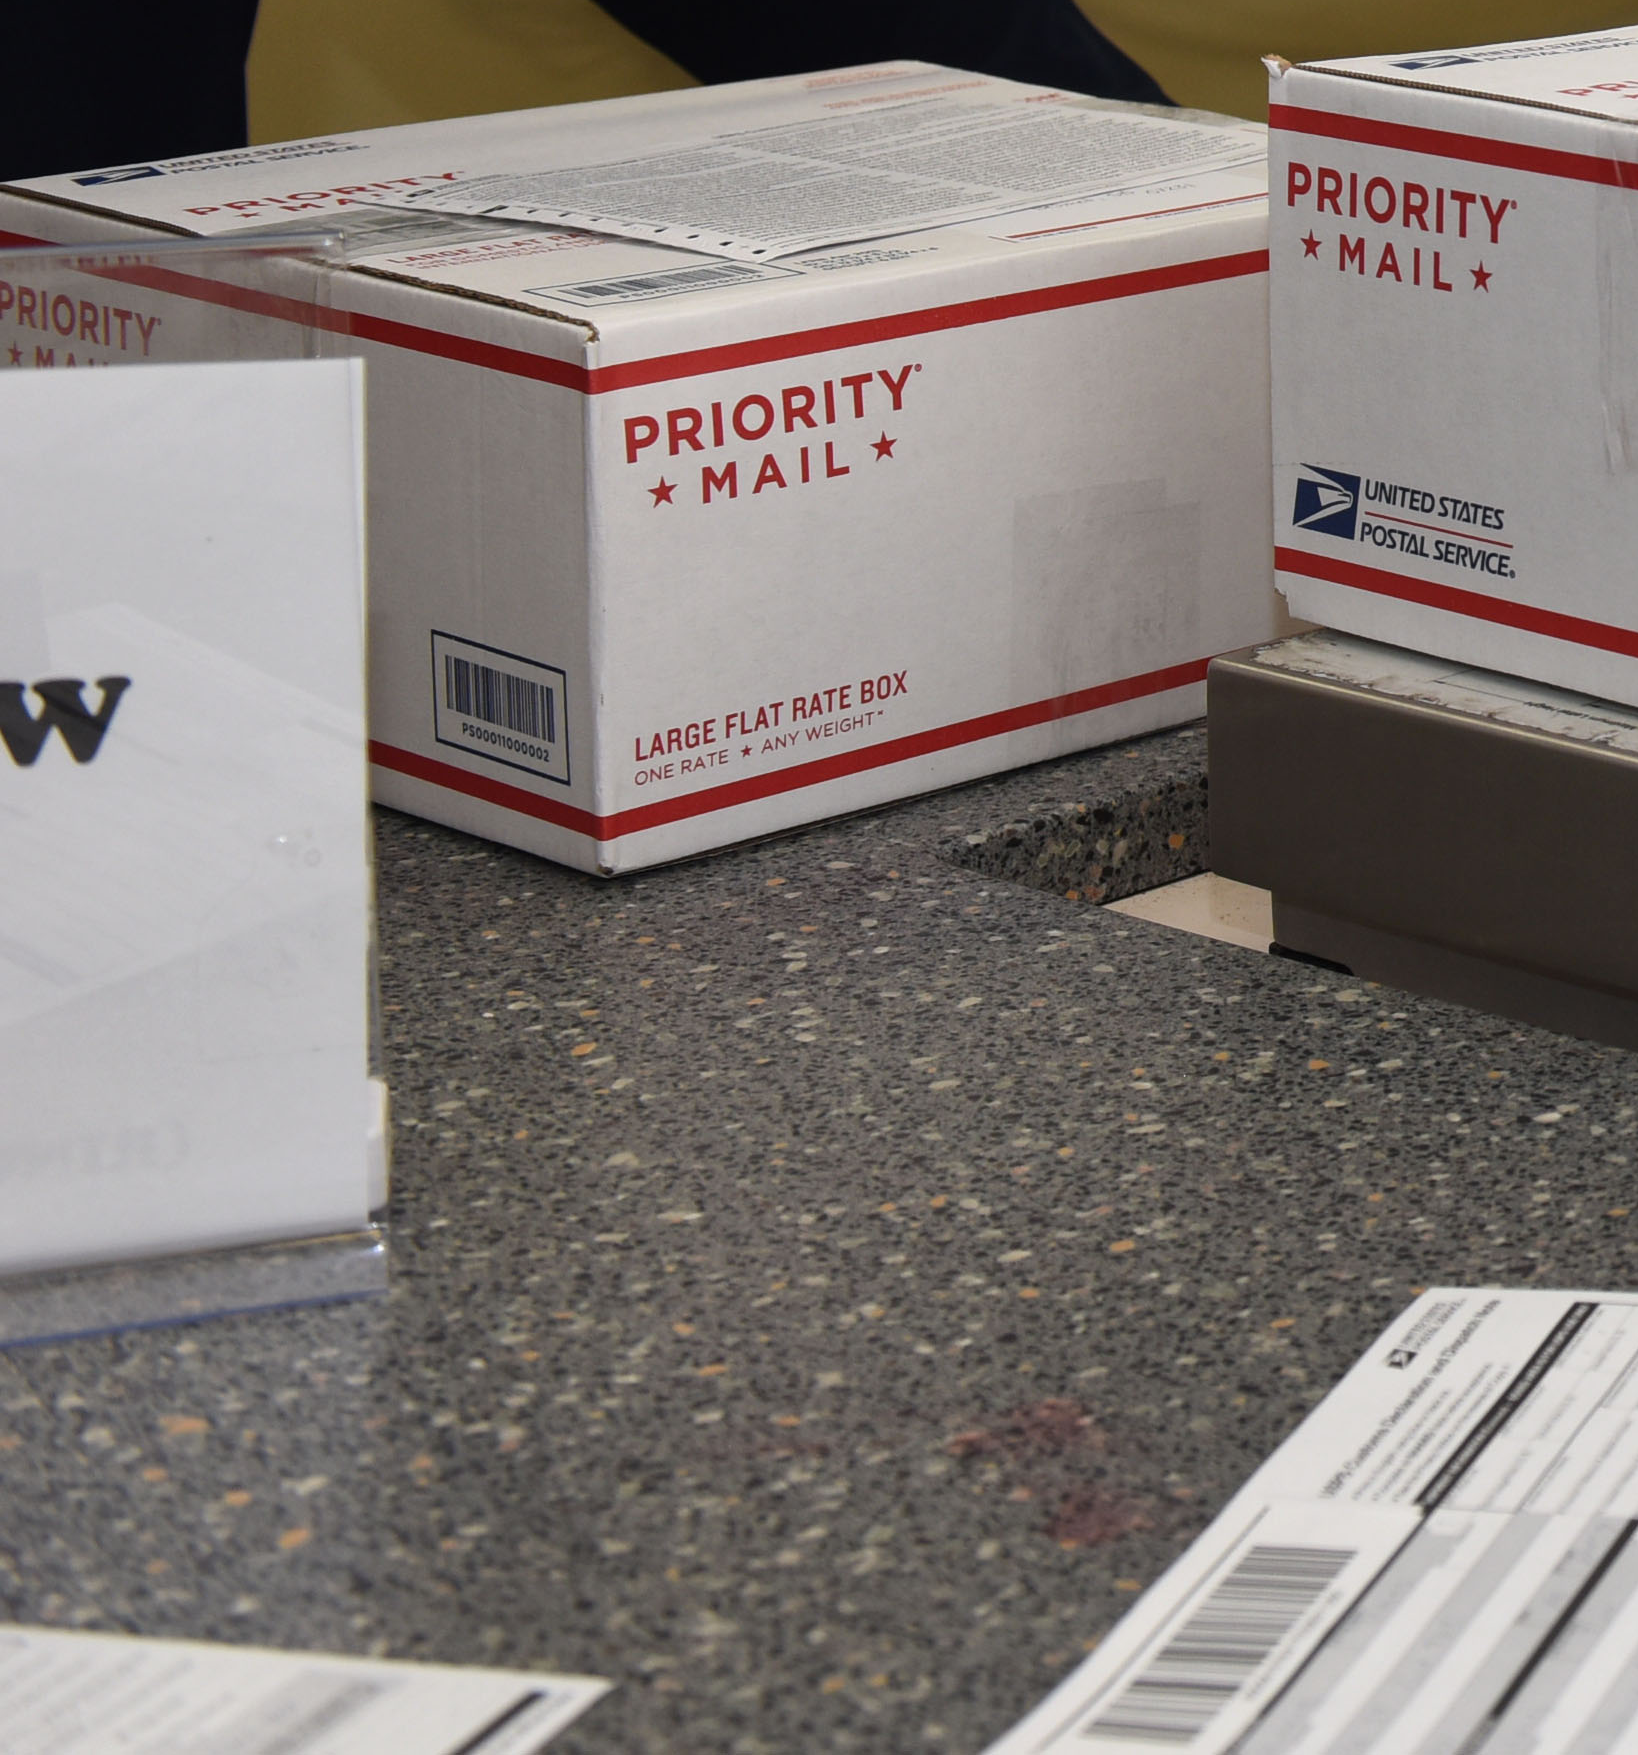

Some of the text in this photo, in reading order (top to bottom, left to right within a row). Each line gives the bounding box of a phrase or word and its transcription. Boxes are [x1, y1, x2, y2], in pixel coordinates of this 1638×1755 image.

[169, 158, 267, 175] POSTAL
[183, 172, 455, 218] PRIORITY
[1286, 162, 1511, 245] PRIORITY
[386, 247, 479, 263] LARGE
[478, 238, 542, 252] FLAT
[1338, 235, 1453, 293] MAIL
[0, 280, 156, 357] PRIORITY
[623, 364, 912, 464] PRIORITY
[702, 439, 850, 505] MAIL
[1363, 477, 1505, 532] UNITED STATES
[1359, 520, 1430, 558] POSTAL
[461, 720, 552, 765] PS00011000002
[634, 669, 908, 763] LARGE FLAT RATE BOX
[634, 763, 674, 786] ONE
[680, 751, 730, 776] RATE
[761, 733, 802, 756] ANY
